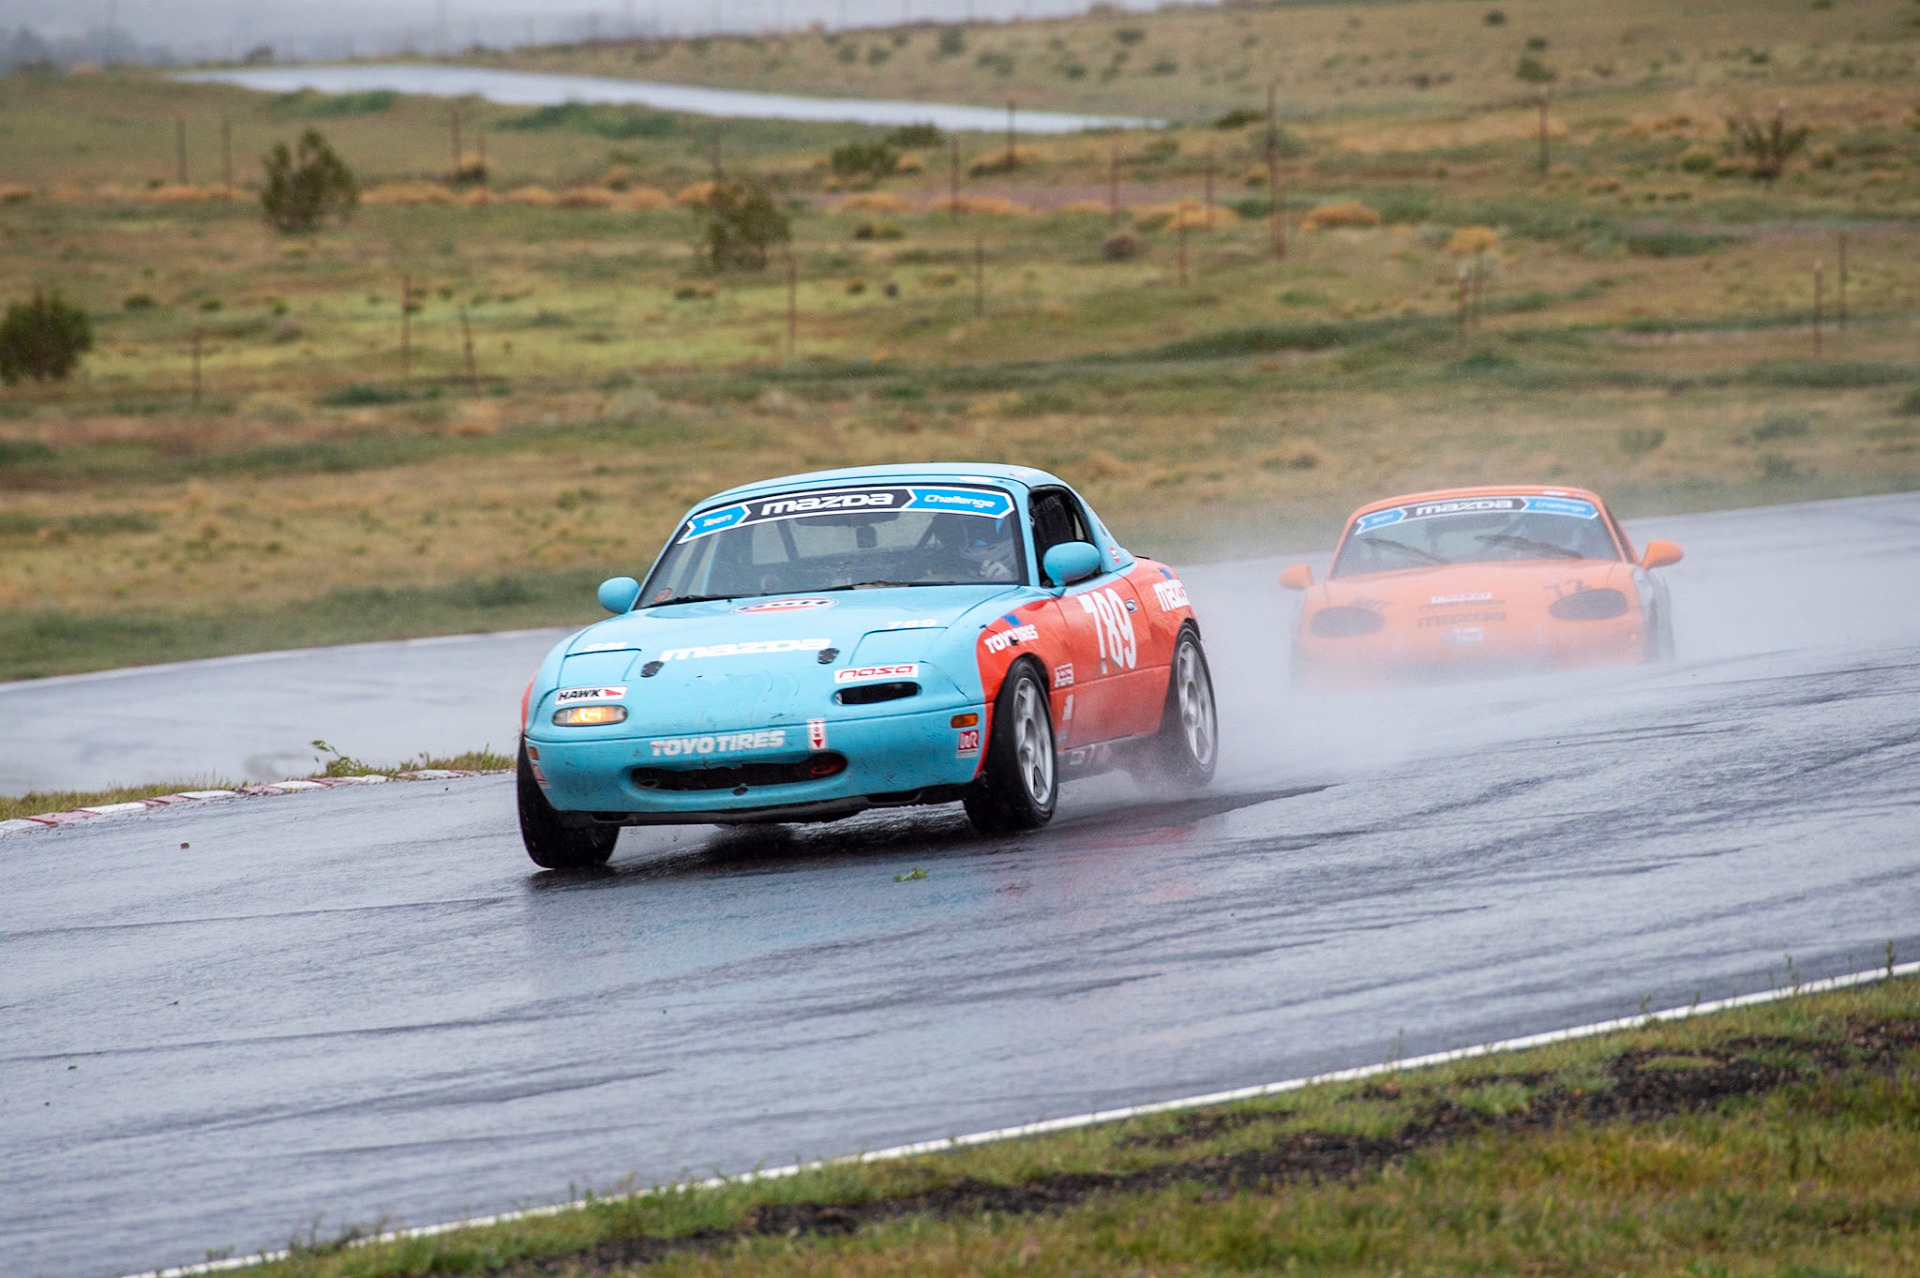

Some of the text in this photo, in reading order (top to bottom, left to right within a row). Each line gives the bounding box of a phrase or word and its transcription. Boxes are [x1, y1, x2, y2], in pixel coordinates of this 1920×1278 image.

[761, 493, 894, 515] mazda
[924, 494, 996, 508] Challenge
[1416, 499, 1514, 516] mazda
[1076, 588, 1137, 674] 789
[658, 638, 832, 662] mazda
[839, 665, 914, 678] nasa
[558, 689, 602, 701] HAWK
[650, 730, 785, 756] TOYO TIRES
